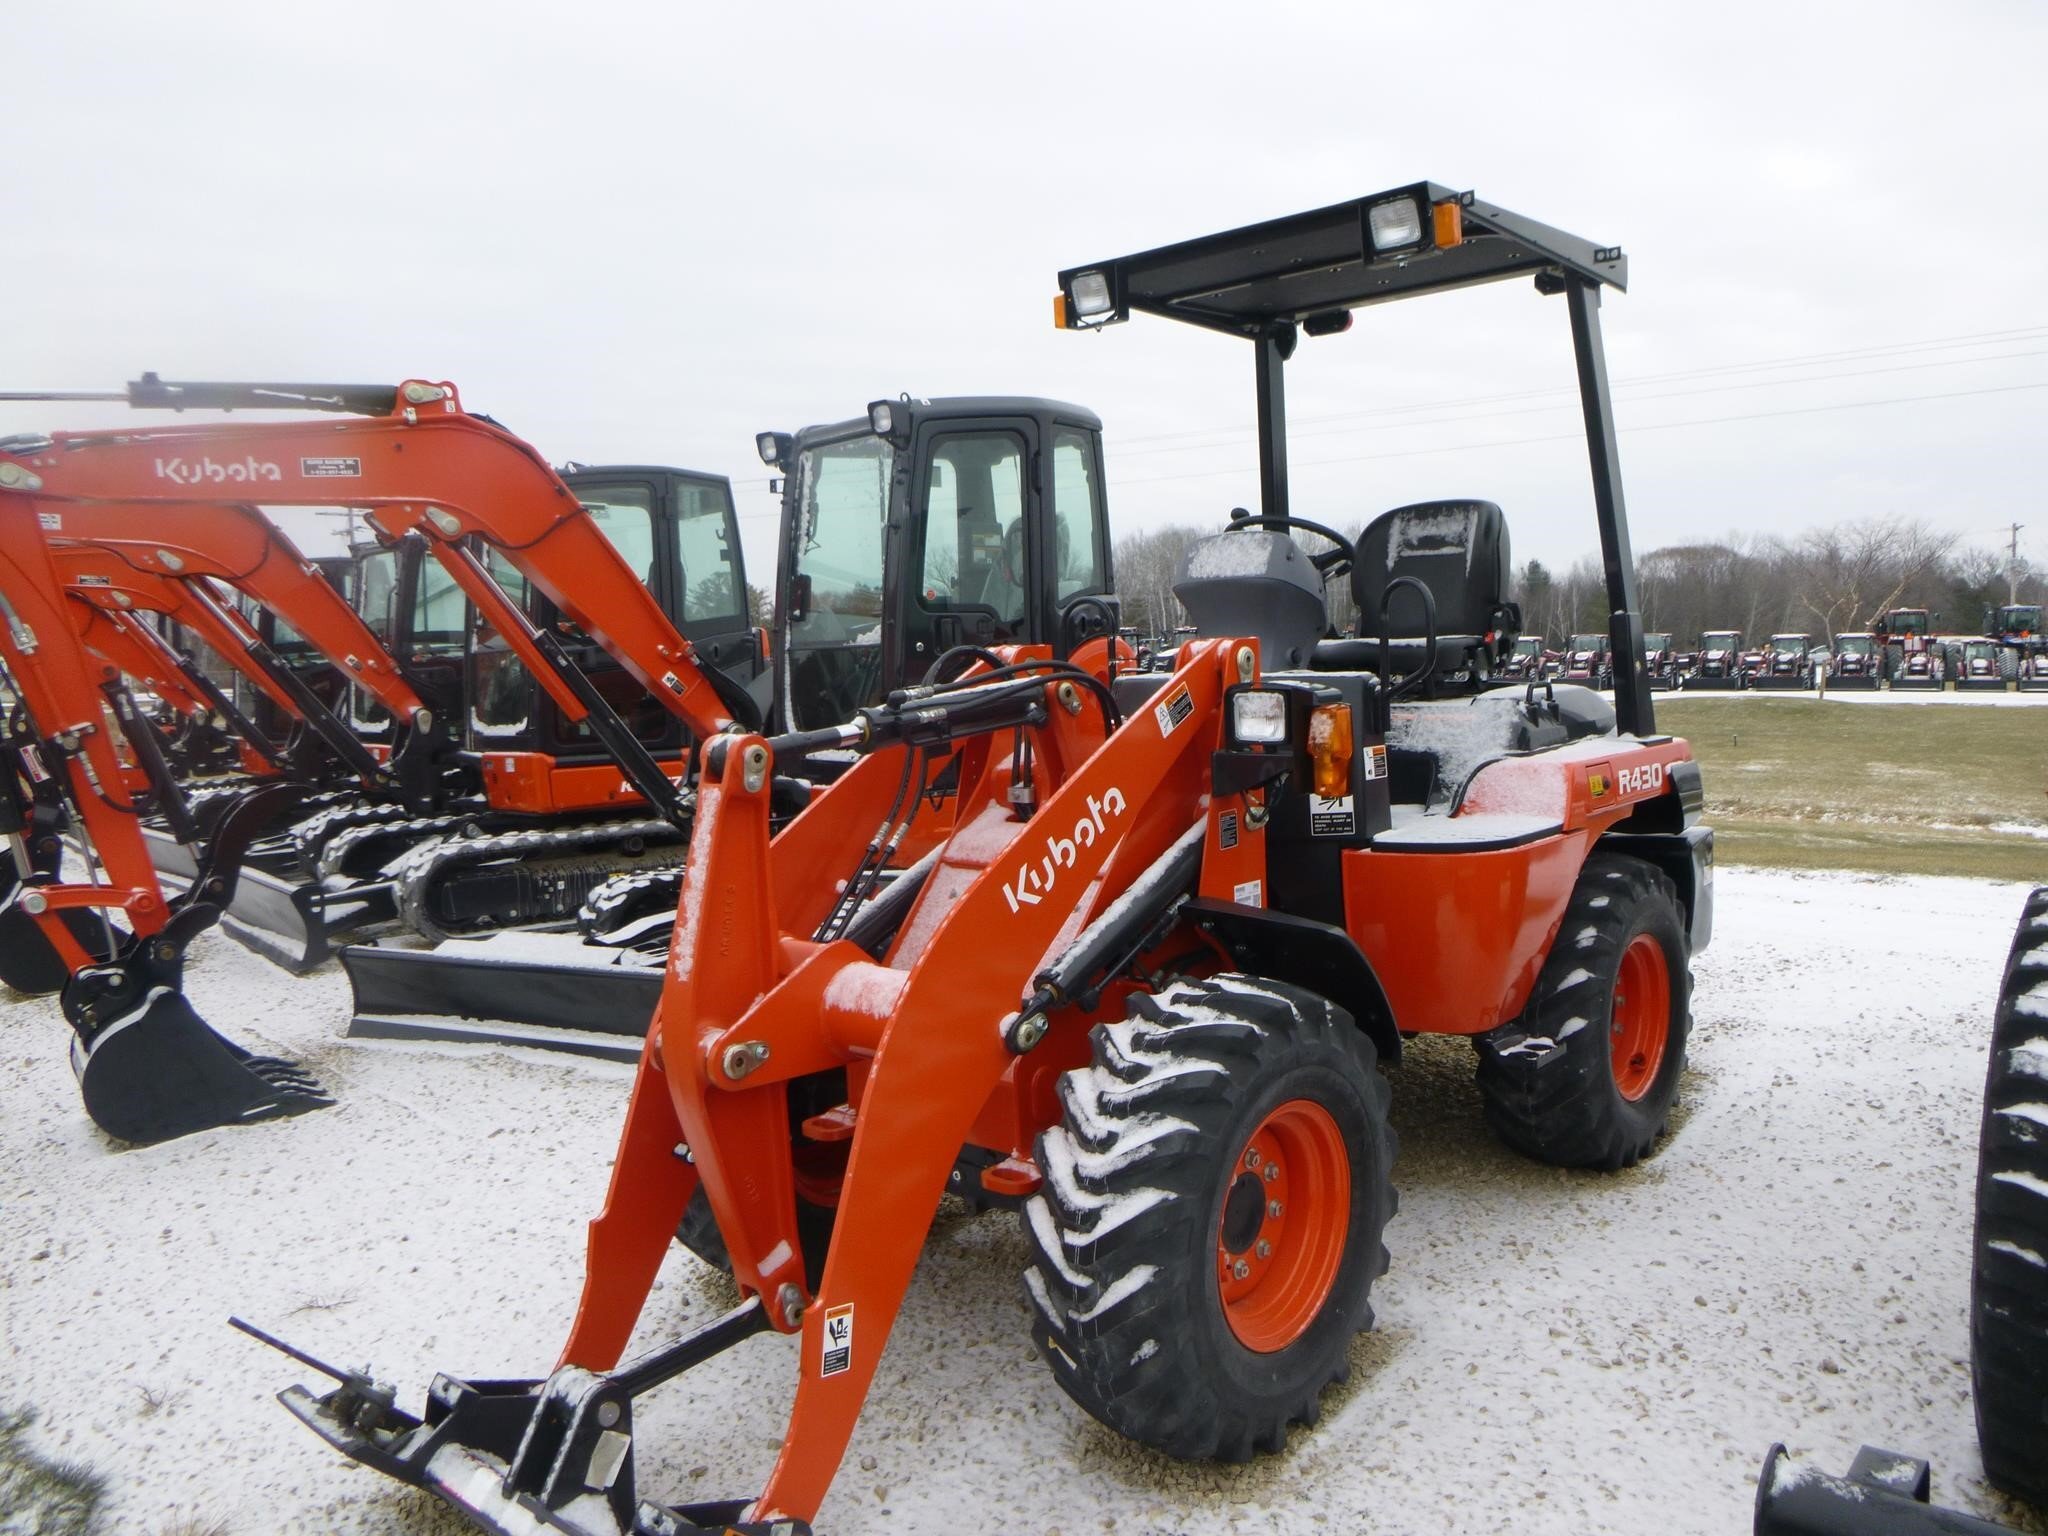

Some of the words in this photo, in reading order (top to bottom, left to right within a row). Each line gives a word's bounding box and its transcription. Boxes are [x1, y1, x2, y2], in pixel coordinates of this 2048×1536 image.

[155, 456, 282, 484] Kubota
[1618, 762, 1663, 795] R430
[1002, 787, 1127, 914] Kubota
